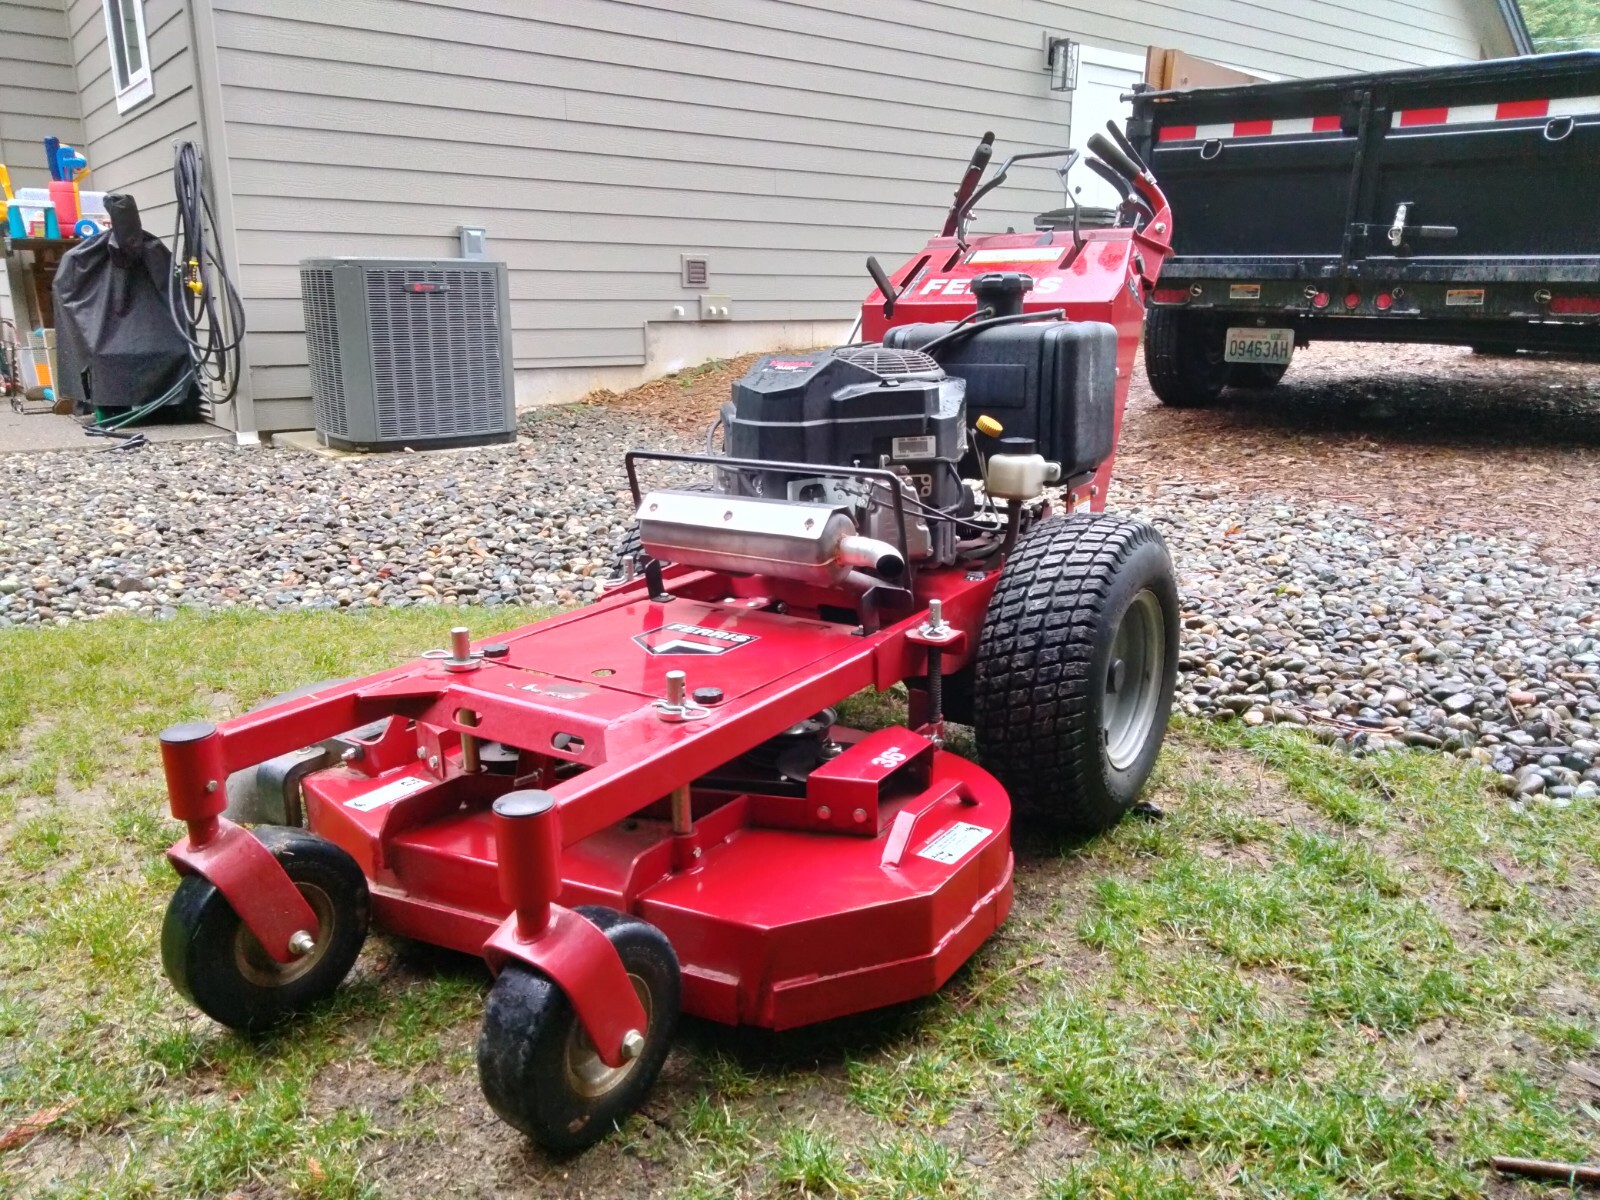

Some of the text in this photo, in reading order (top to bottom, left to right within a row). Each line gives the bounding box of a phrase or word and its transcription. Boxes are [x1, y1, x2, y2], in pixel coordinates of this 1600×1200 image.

[919, 276, 1064, 295] FES
[1229, 340, 1289, 359] 09463AH
[666, 623, 751, 643] FERRIS
